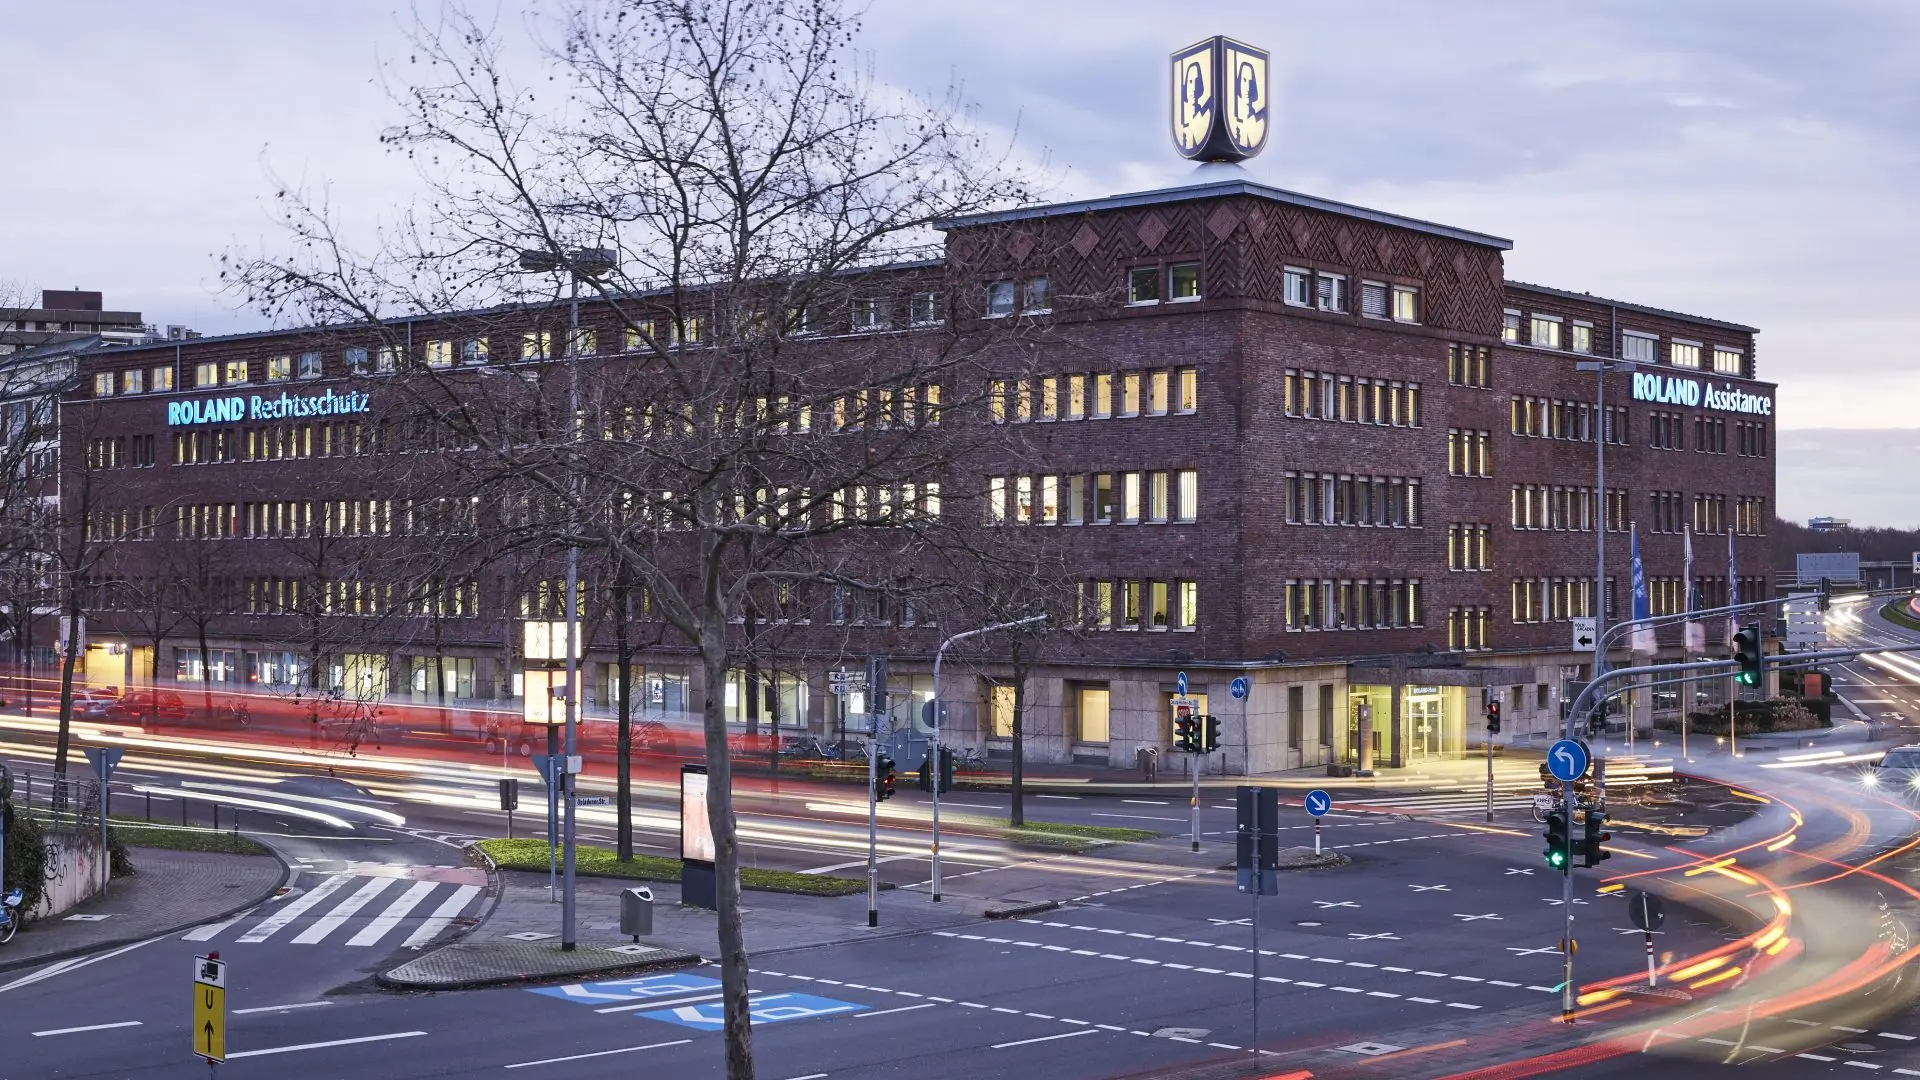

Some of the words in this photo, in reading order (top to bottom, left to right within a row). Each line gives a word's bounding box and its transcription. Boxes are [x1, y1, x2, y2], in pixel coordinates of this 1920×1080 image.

[168, 396, 245, 426] ROLAND
[251, 388, 370, 420] Rechtsschutz
[1633, 372, 1700, 407] ROLAND
[1704, 383, 1771, 415] Assistance
[205, 989, 214, 1010] U
